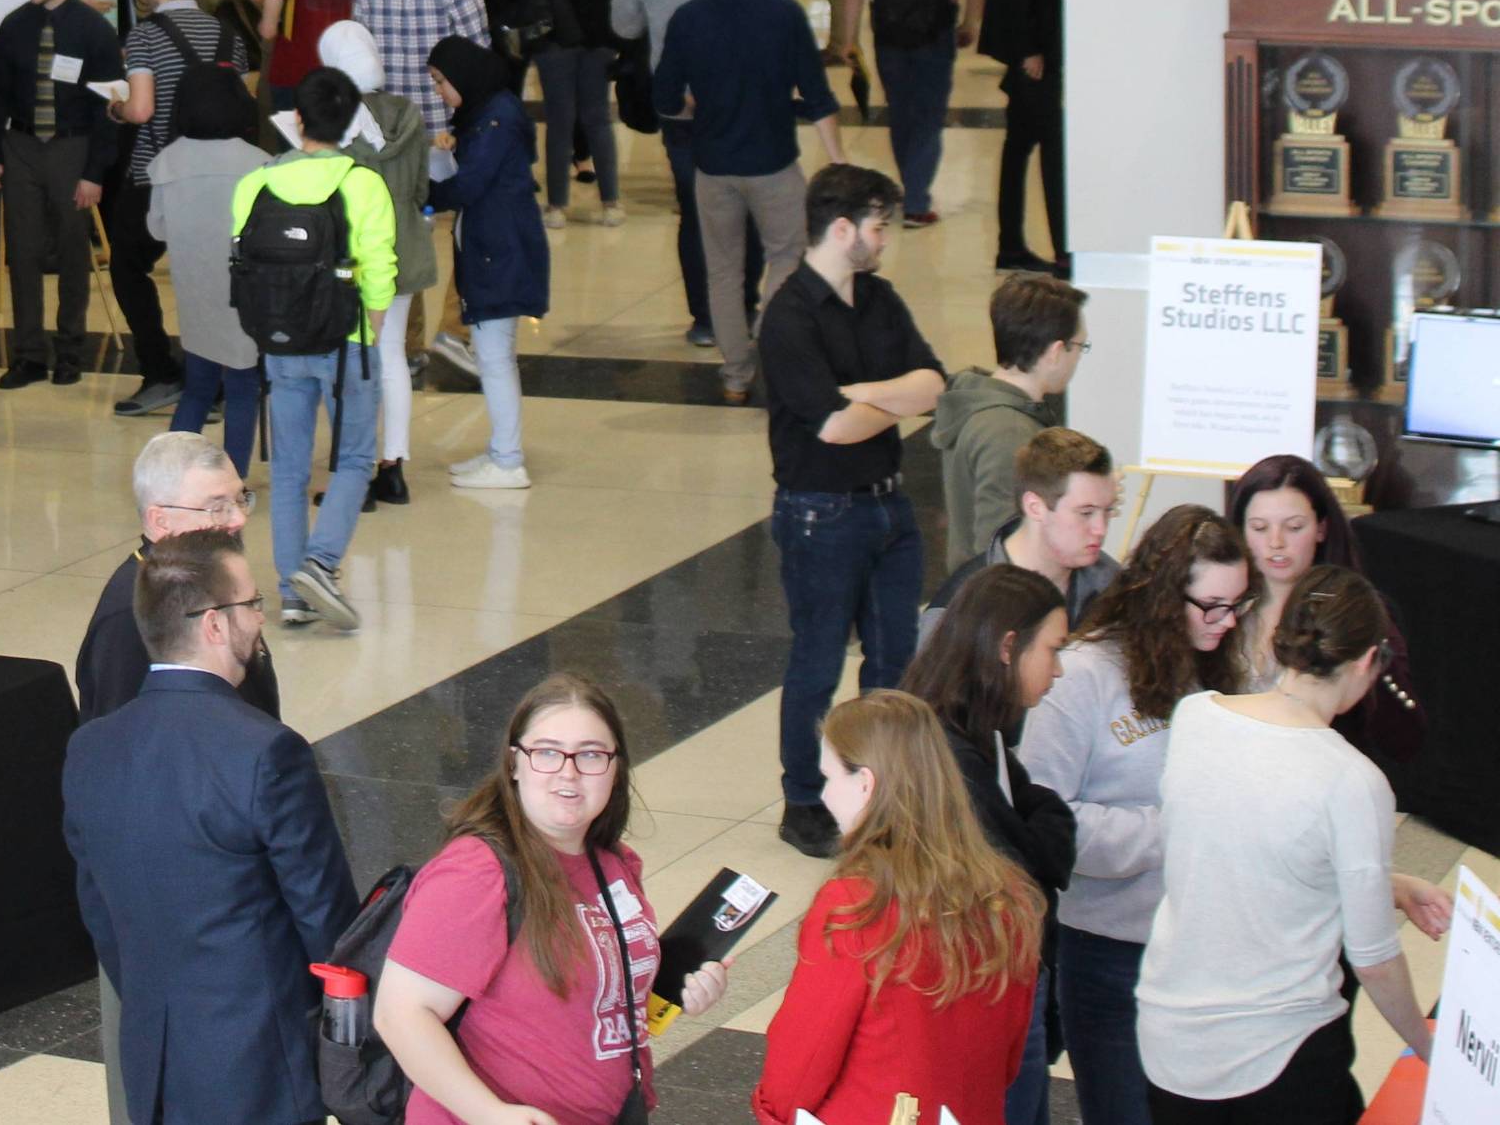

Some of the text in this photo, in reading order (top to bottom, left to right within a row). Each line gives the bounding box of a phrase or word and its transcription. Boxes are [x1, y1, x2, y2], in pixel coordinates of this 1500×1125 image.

[1182, 282, 1287, 309] Steffens
[1161, 305, 1306, 335] Studios LLC
